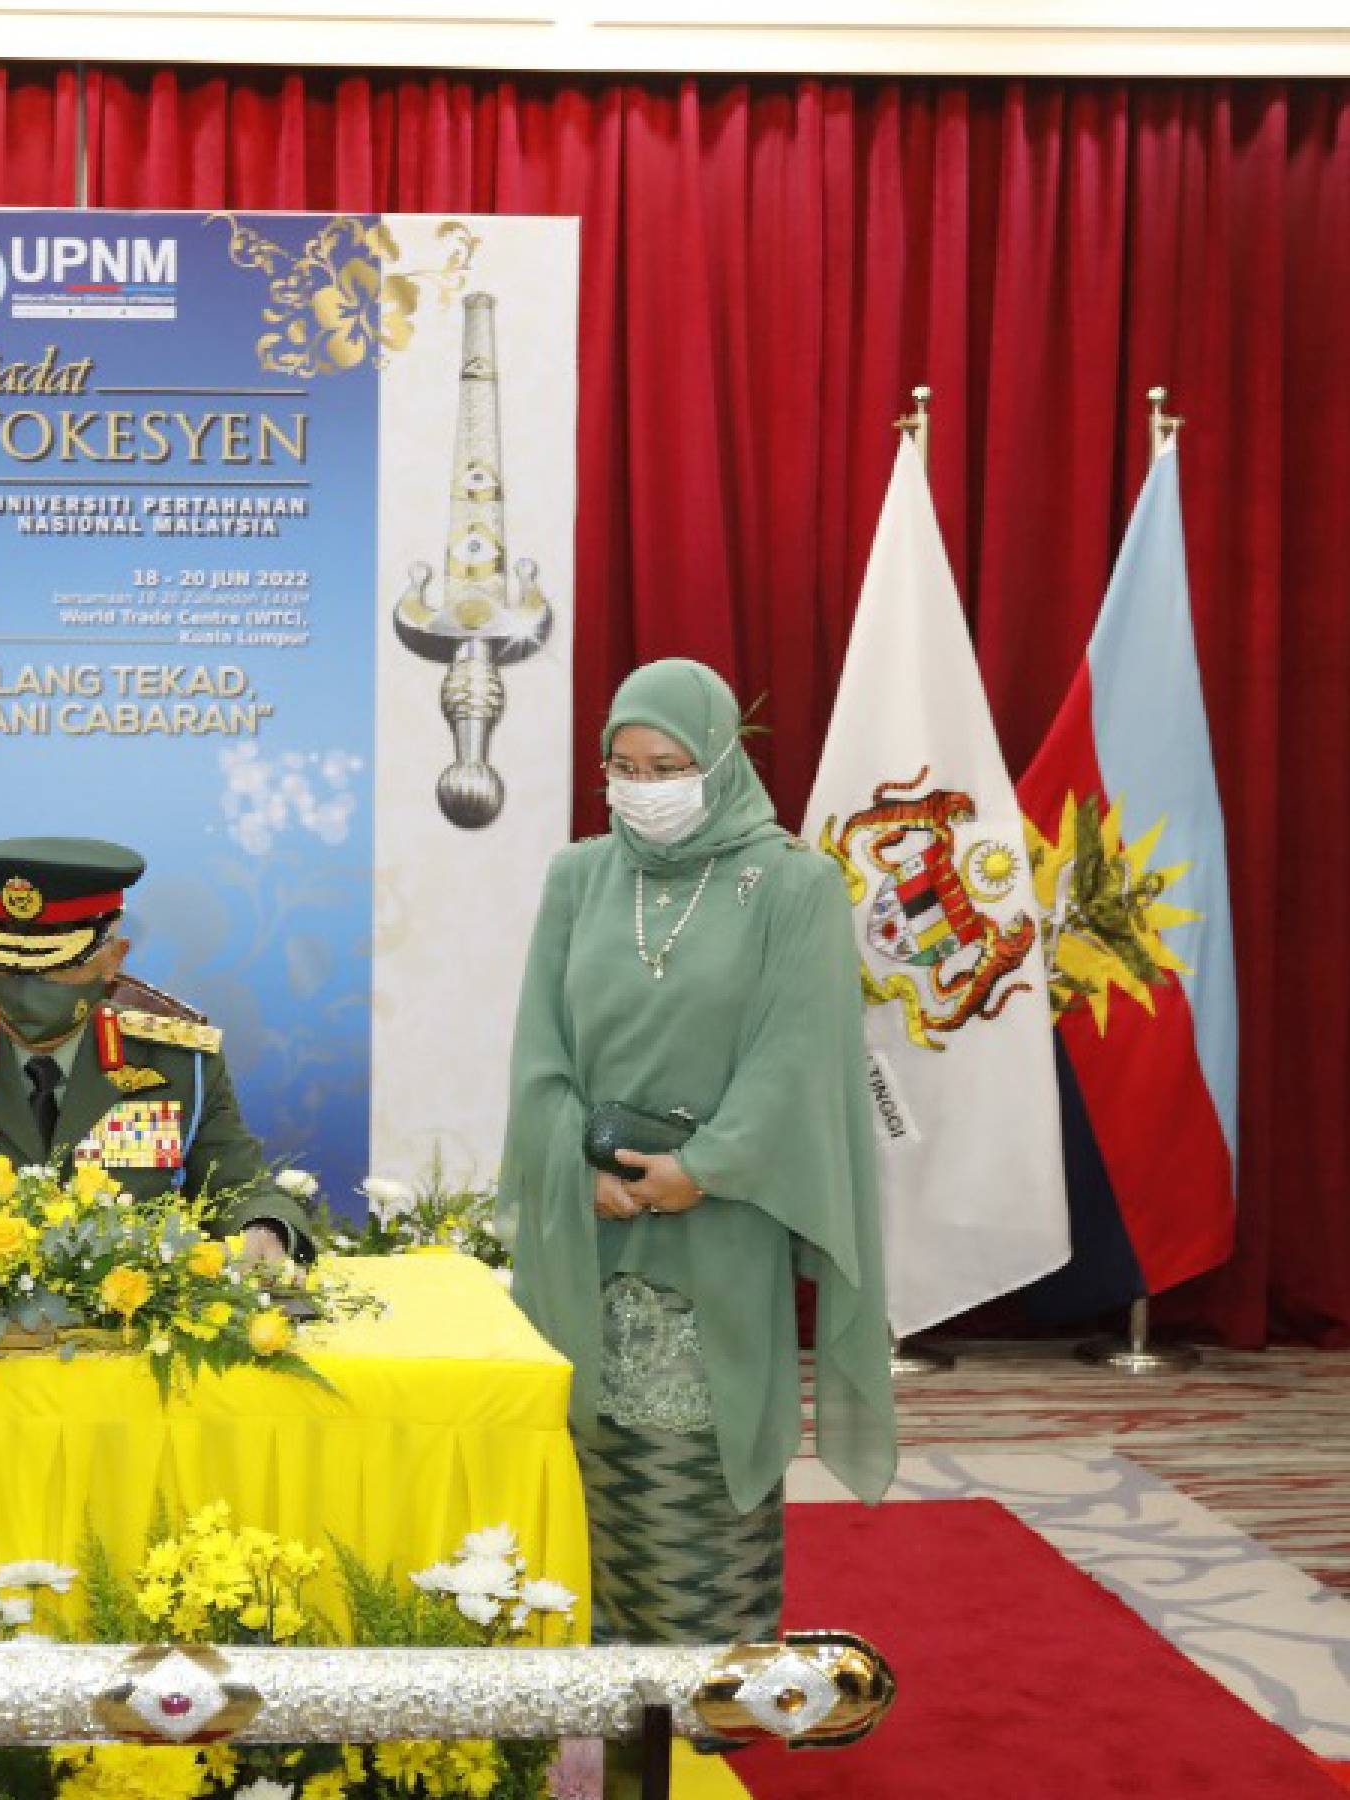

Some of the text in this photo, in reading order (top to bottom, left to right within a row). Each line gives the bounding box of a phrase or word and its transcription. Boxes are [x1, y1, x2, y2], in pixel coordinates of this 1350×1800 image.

[11, 236, 178, 283] UPNM
[143, 496, 309, 518] PERTAHANAN
[17, 514, 281, 538] NASIONAL MALAYSIA
[133, 568, 161, 588] 18
[178, 569, 206, 588] 20
[208, 569, 251, 590] JUN
[254, 569, 311, 588] 2022
[58, 607, 115, 626] World
[119, 607, 173, 627] Trade
[176, 608, 241, 627] Centre
[178, 629, 310, 650] Kuala Lumpur
[108, 664, 258, 703] TEKAD,
